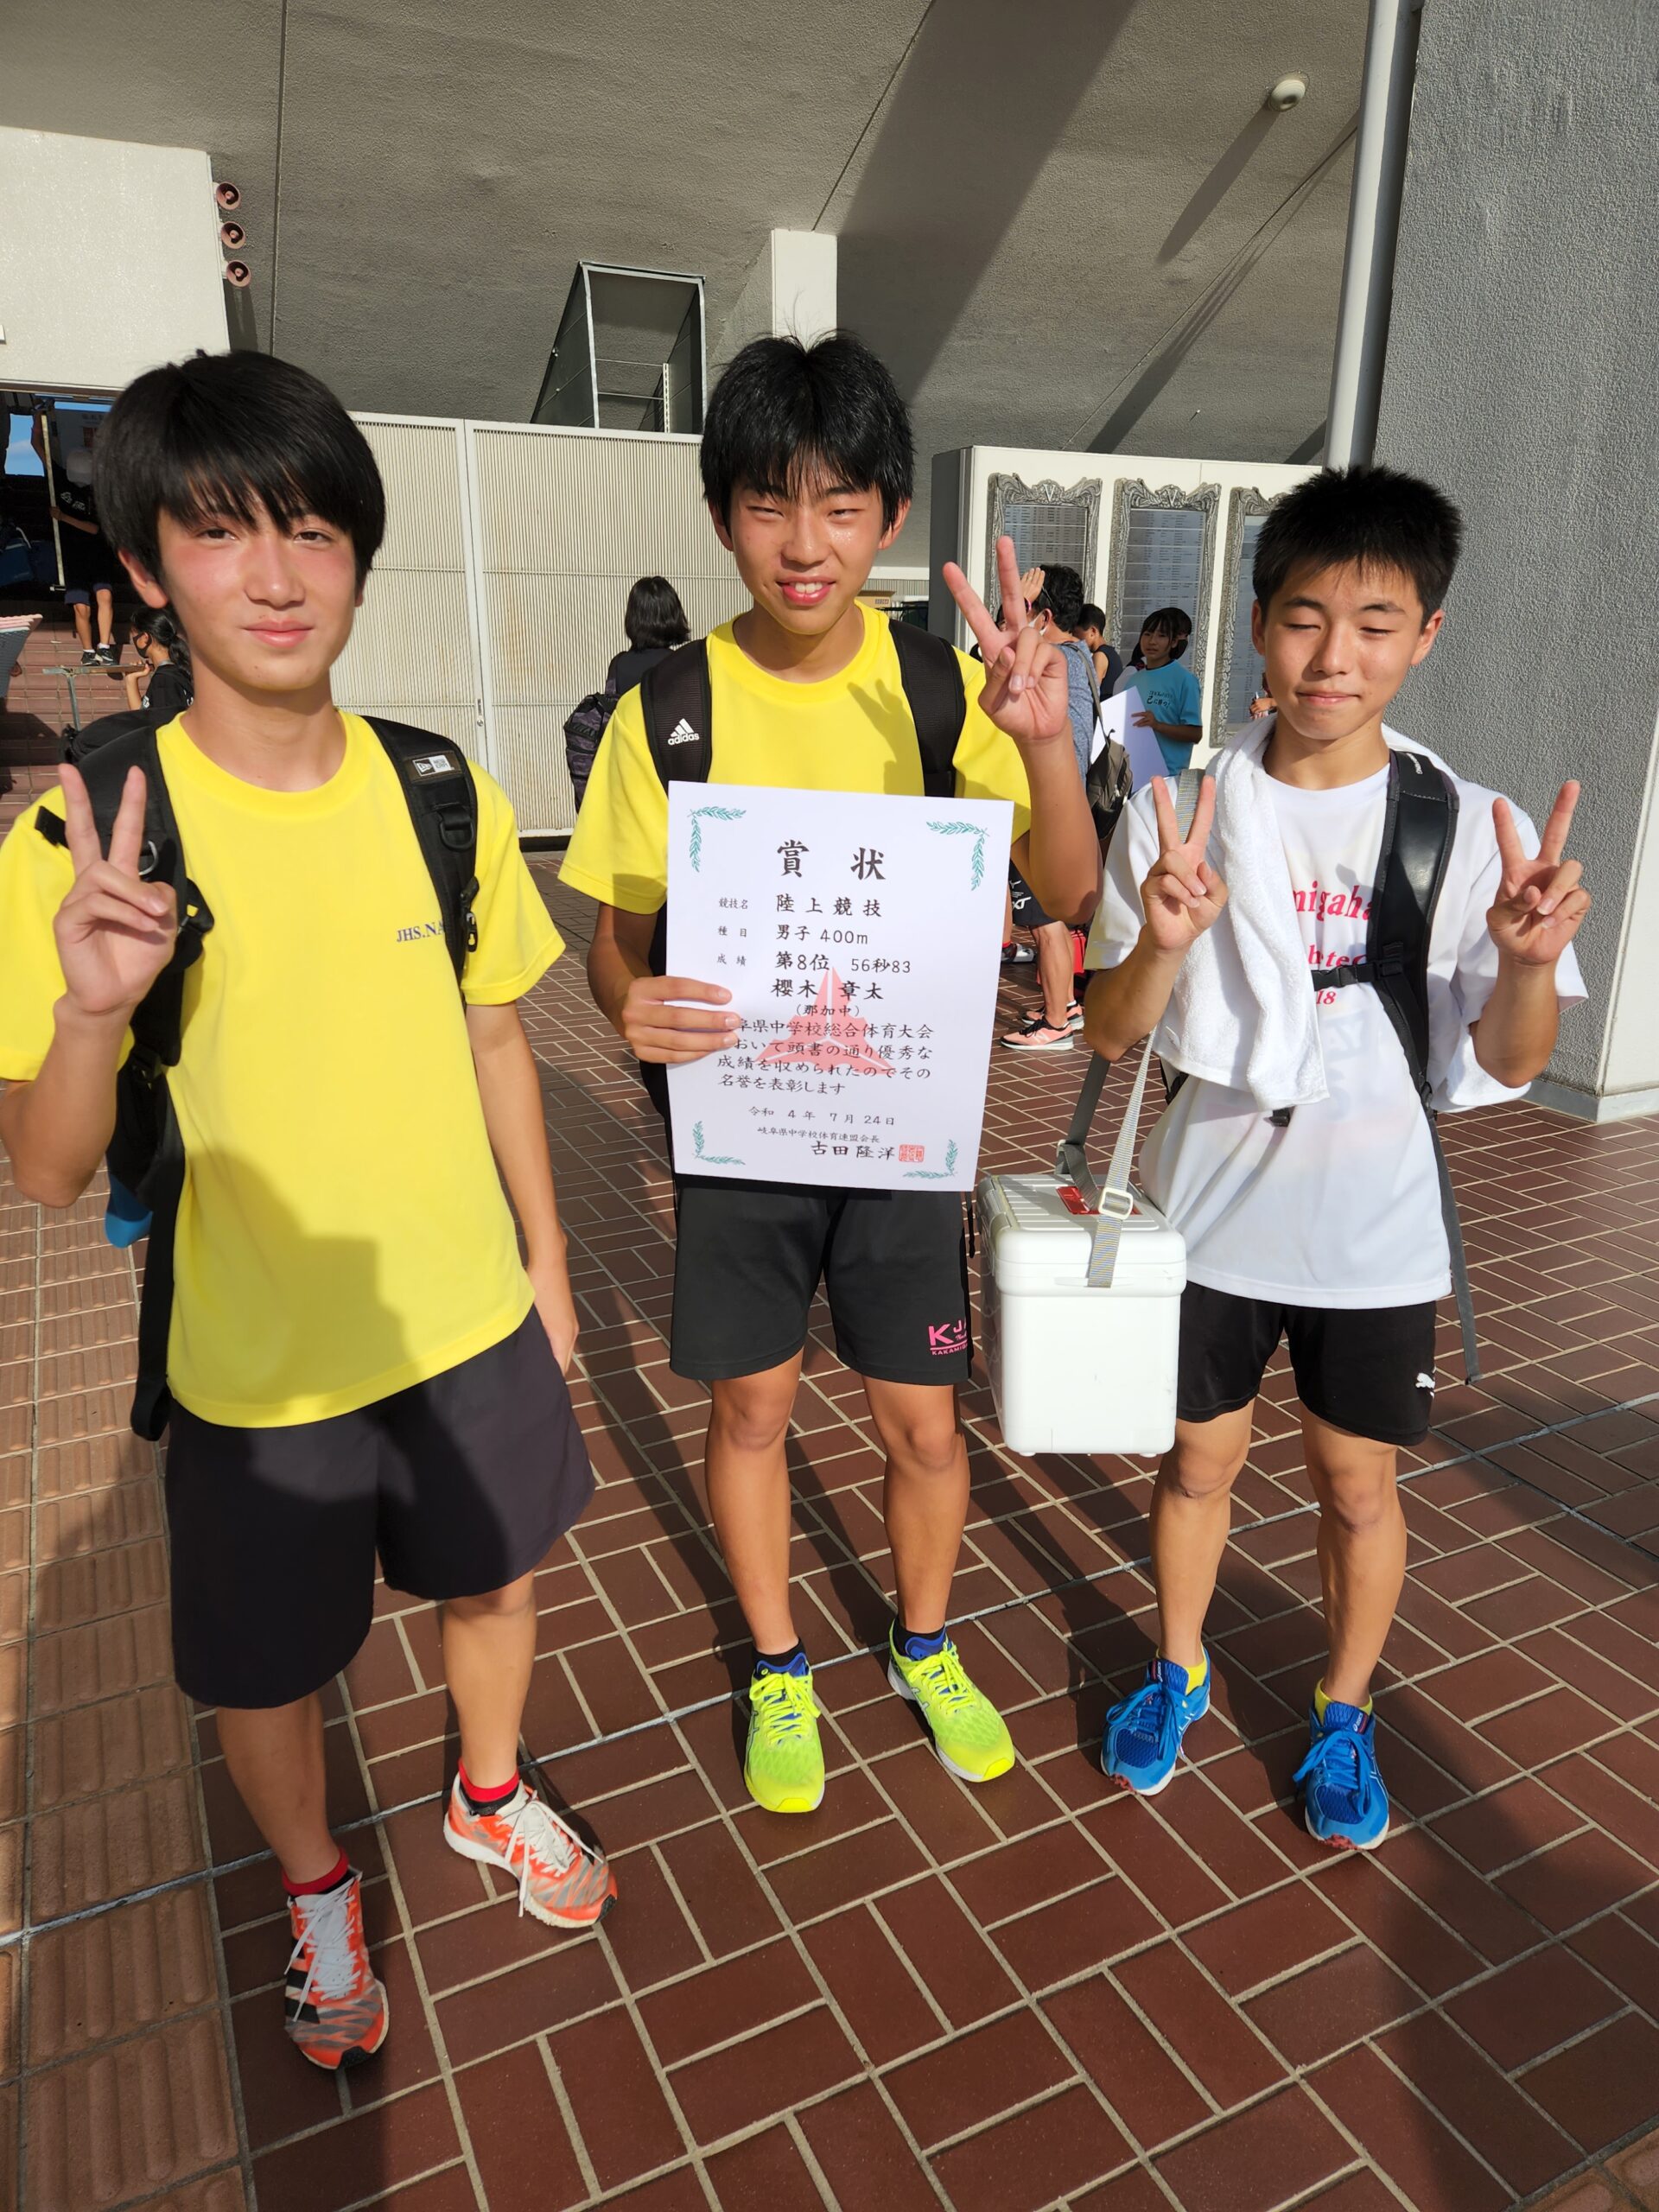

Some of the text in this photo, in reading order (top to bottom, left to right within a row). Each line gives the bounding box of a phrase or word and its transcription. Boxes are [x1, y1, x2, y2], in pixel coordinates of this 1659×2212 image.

[668, 733, 699, 745] adidas
[718, 893, 882, 918] 競技名 陸上競技
[716, 925, 747, 938] 種目
[716, 950, 912, 974] 成績 第8位 56秒83
[717, 1054, 931, 1079] 成績を収められたのでその
[719, 1074, 846, 1095] 名誉を表彰します
